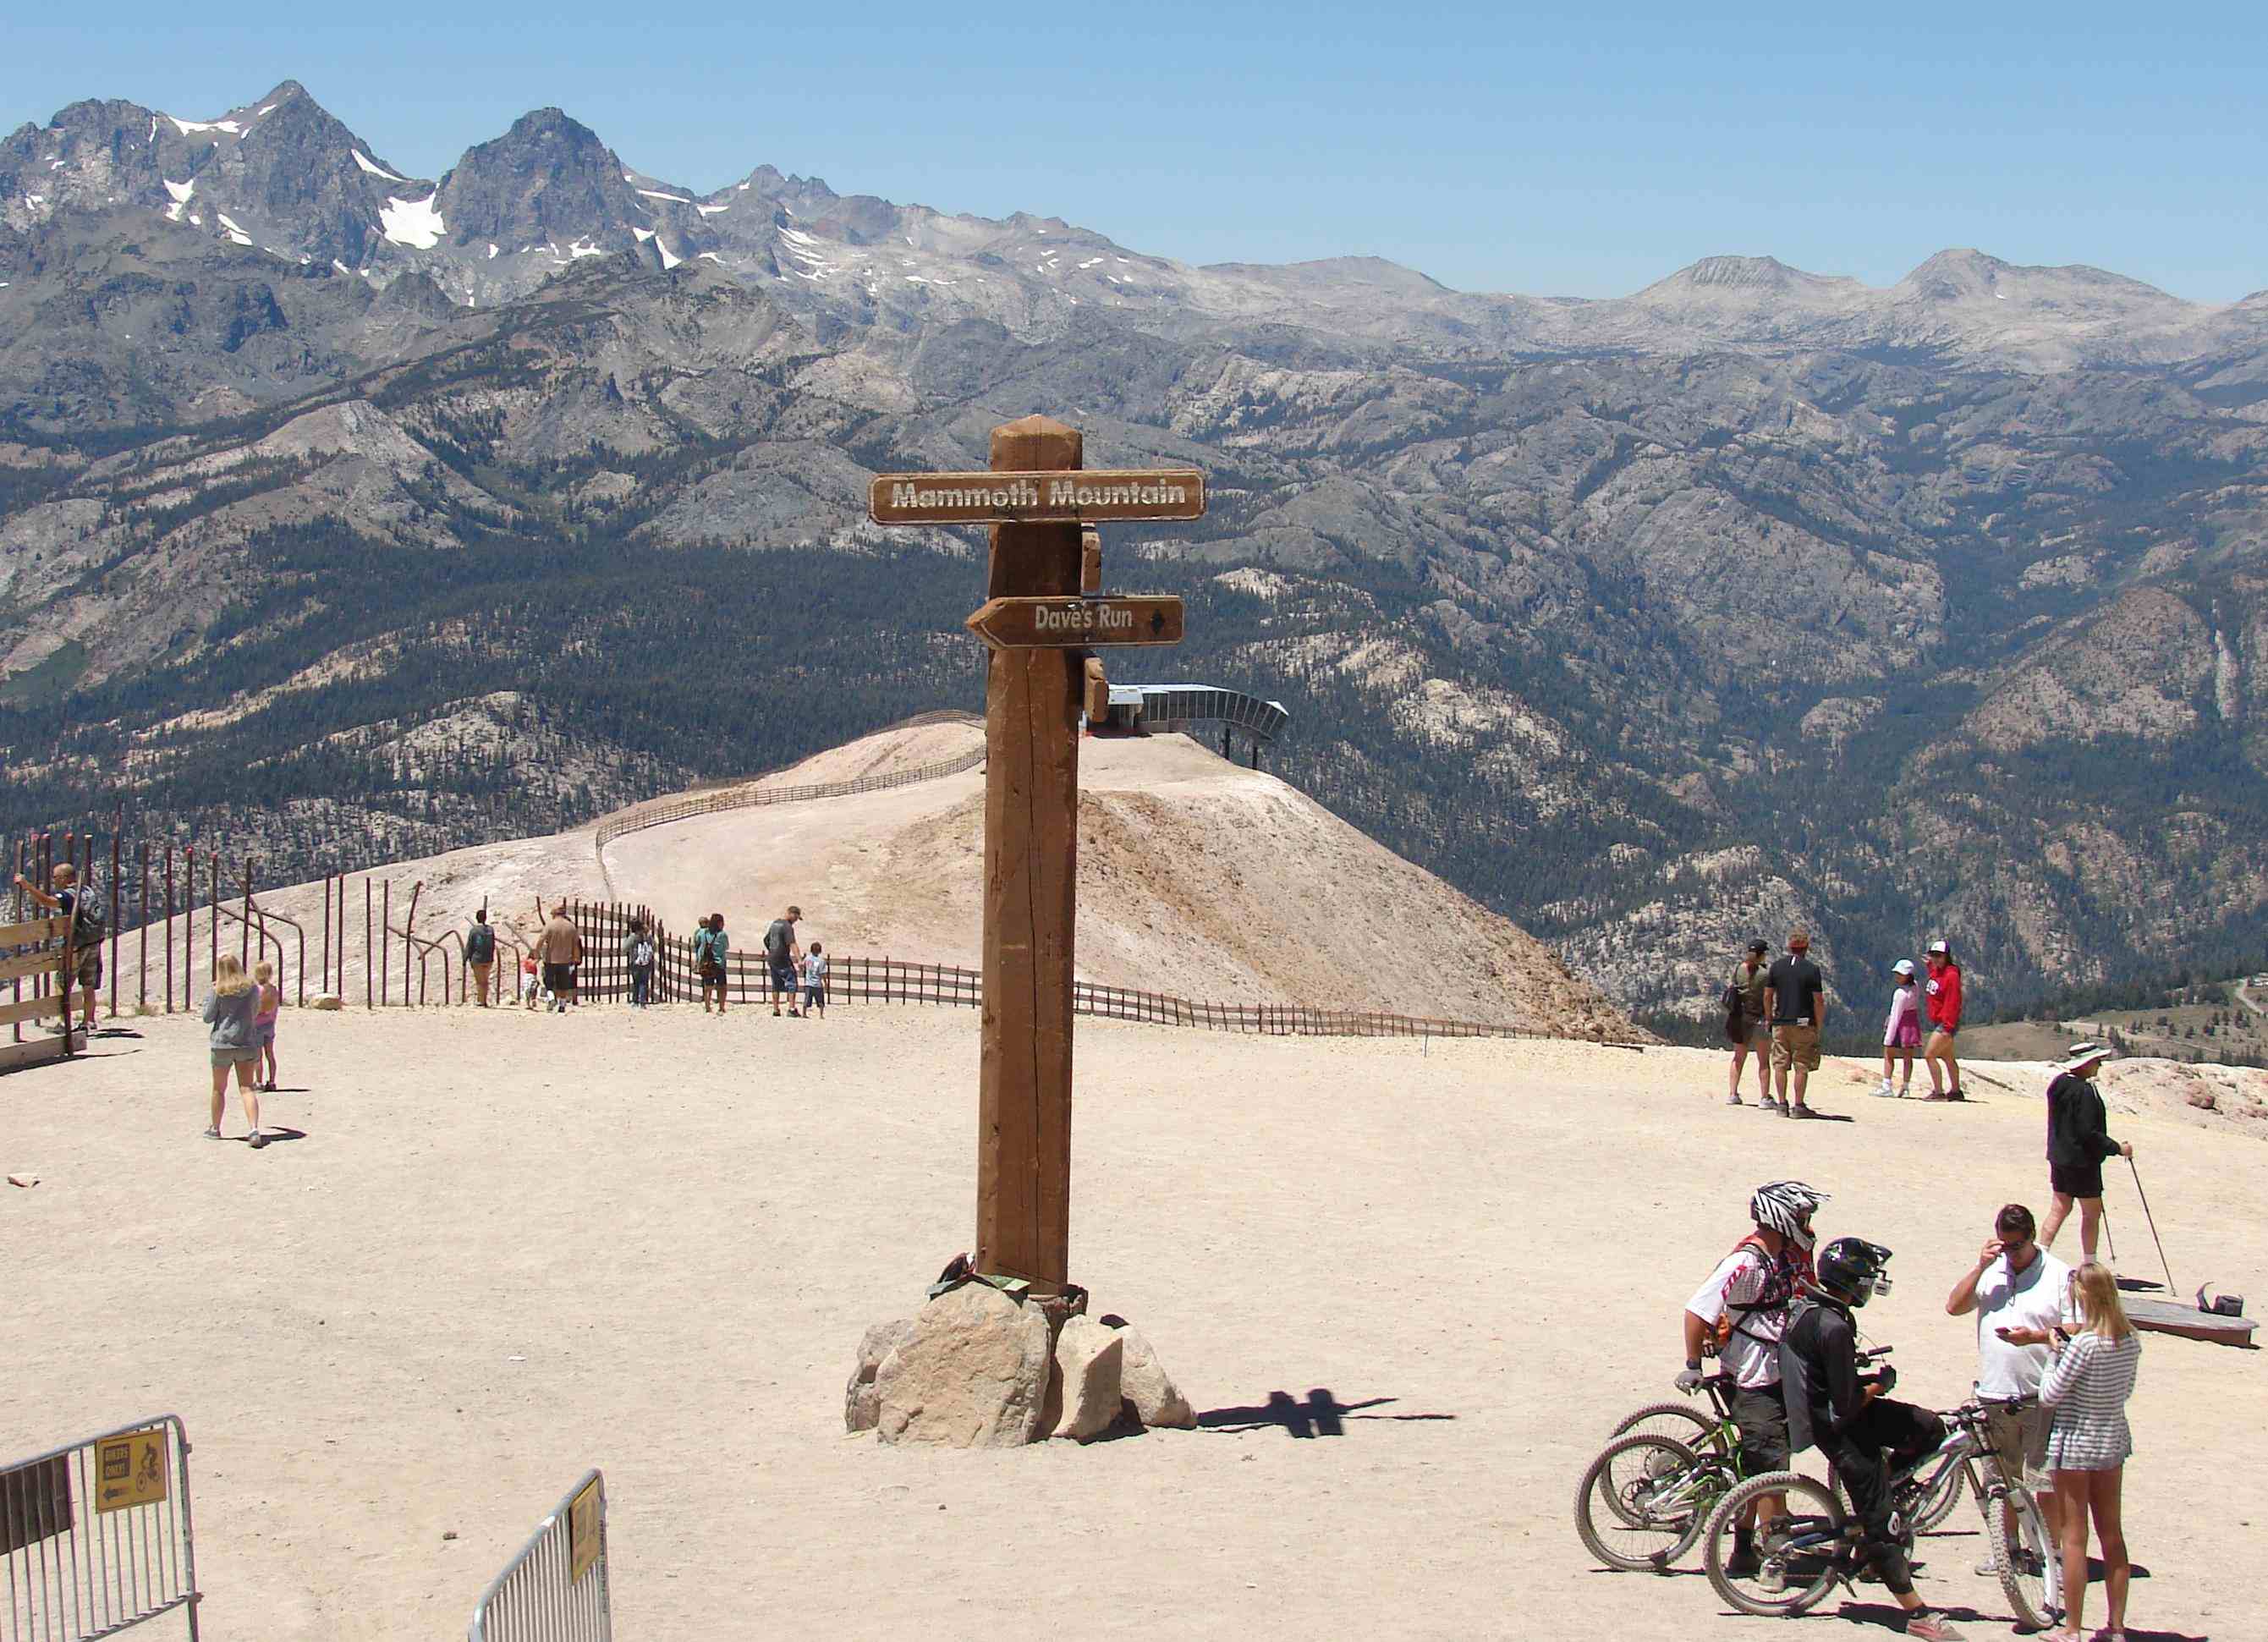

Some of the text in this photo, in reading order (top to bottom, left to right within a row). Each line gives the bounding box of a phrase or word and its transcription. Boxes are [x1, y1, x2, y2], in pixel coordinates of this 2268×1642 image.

[892, 478, 1185, 508] Mammoth Mountain
[1035, 603, 1132, 629] Dave's Run
